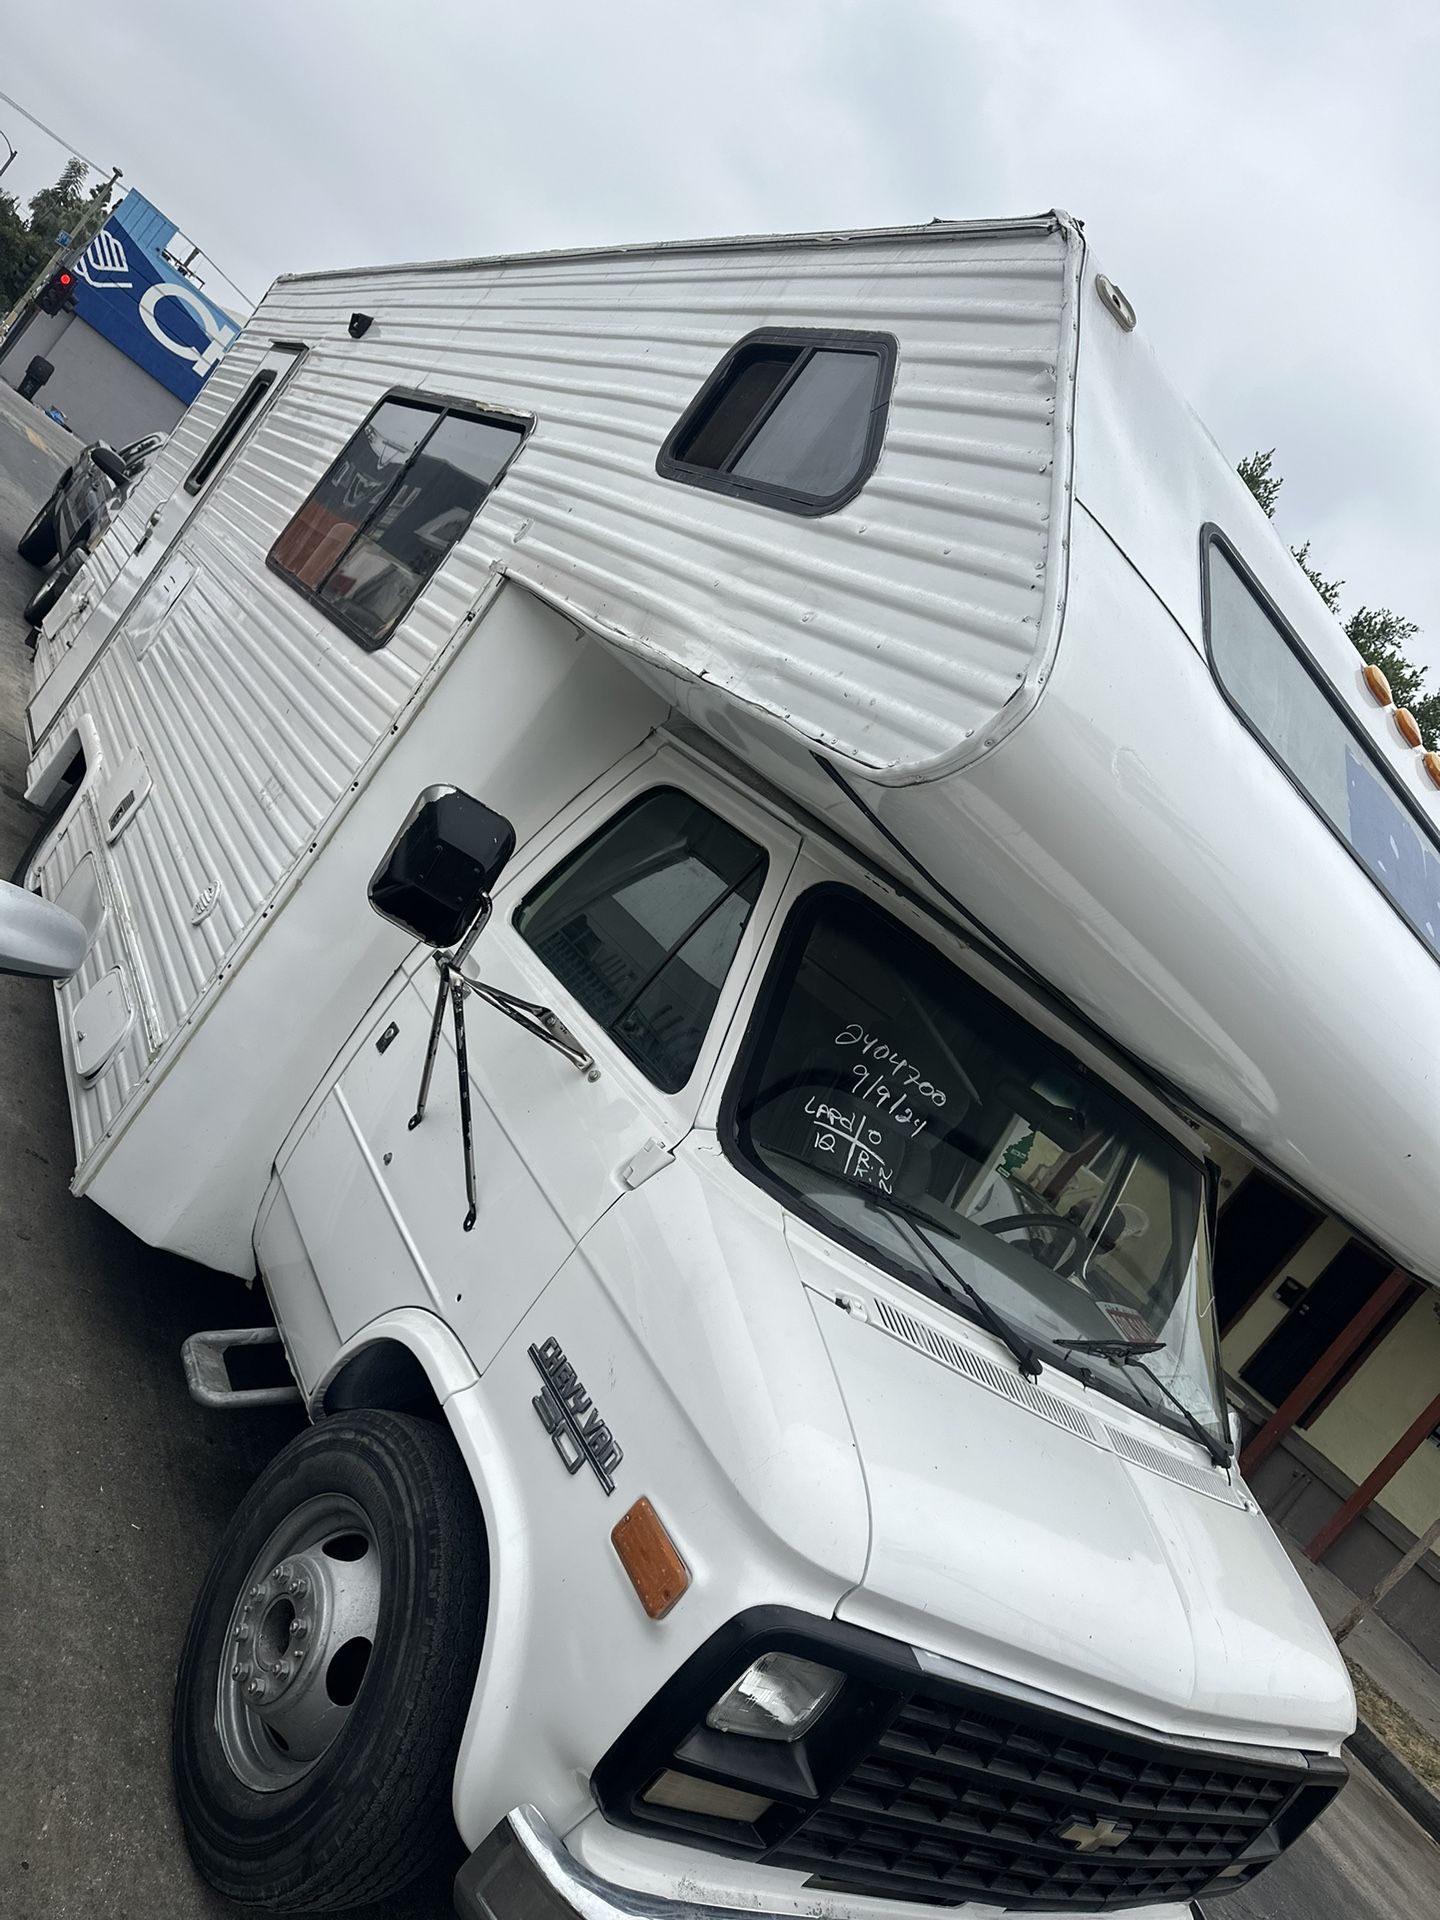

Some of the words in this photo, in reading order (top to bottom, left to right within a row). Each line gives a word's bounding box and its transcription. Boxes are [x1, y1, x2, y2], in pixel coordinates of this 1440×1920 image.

[835, 1023, 947, 1107] 2404700
[852, 1064, 927, 1138] 9/9/24
[532, 1385, 586, 1475] 30
[538, 1335, 593, 1416] CHEVY
[583, 1408, 624, 1475] VAN
